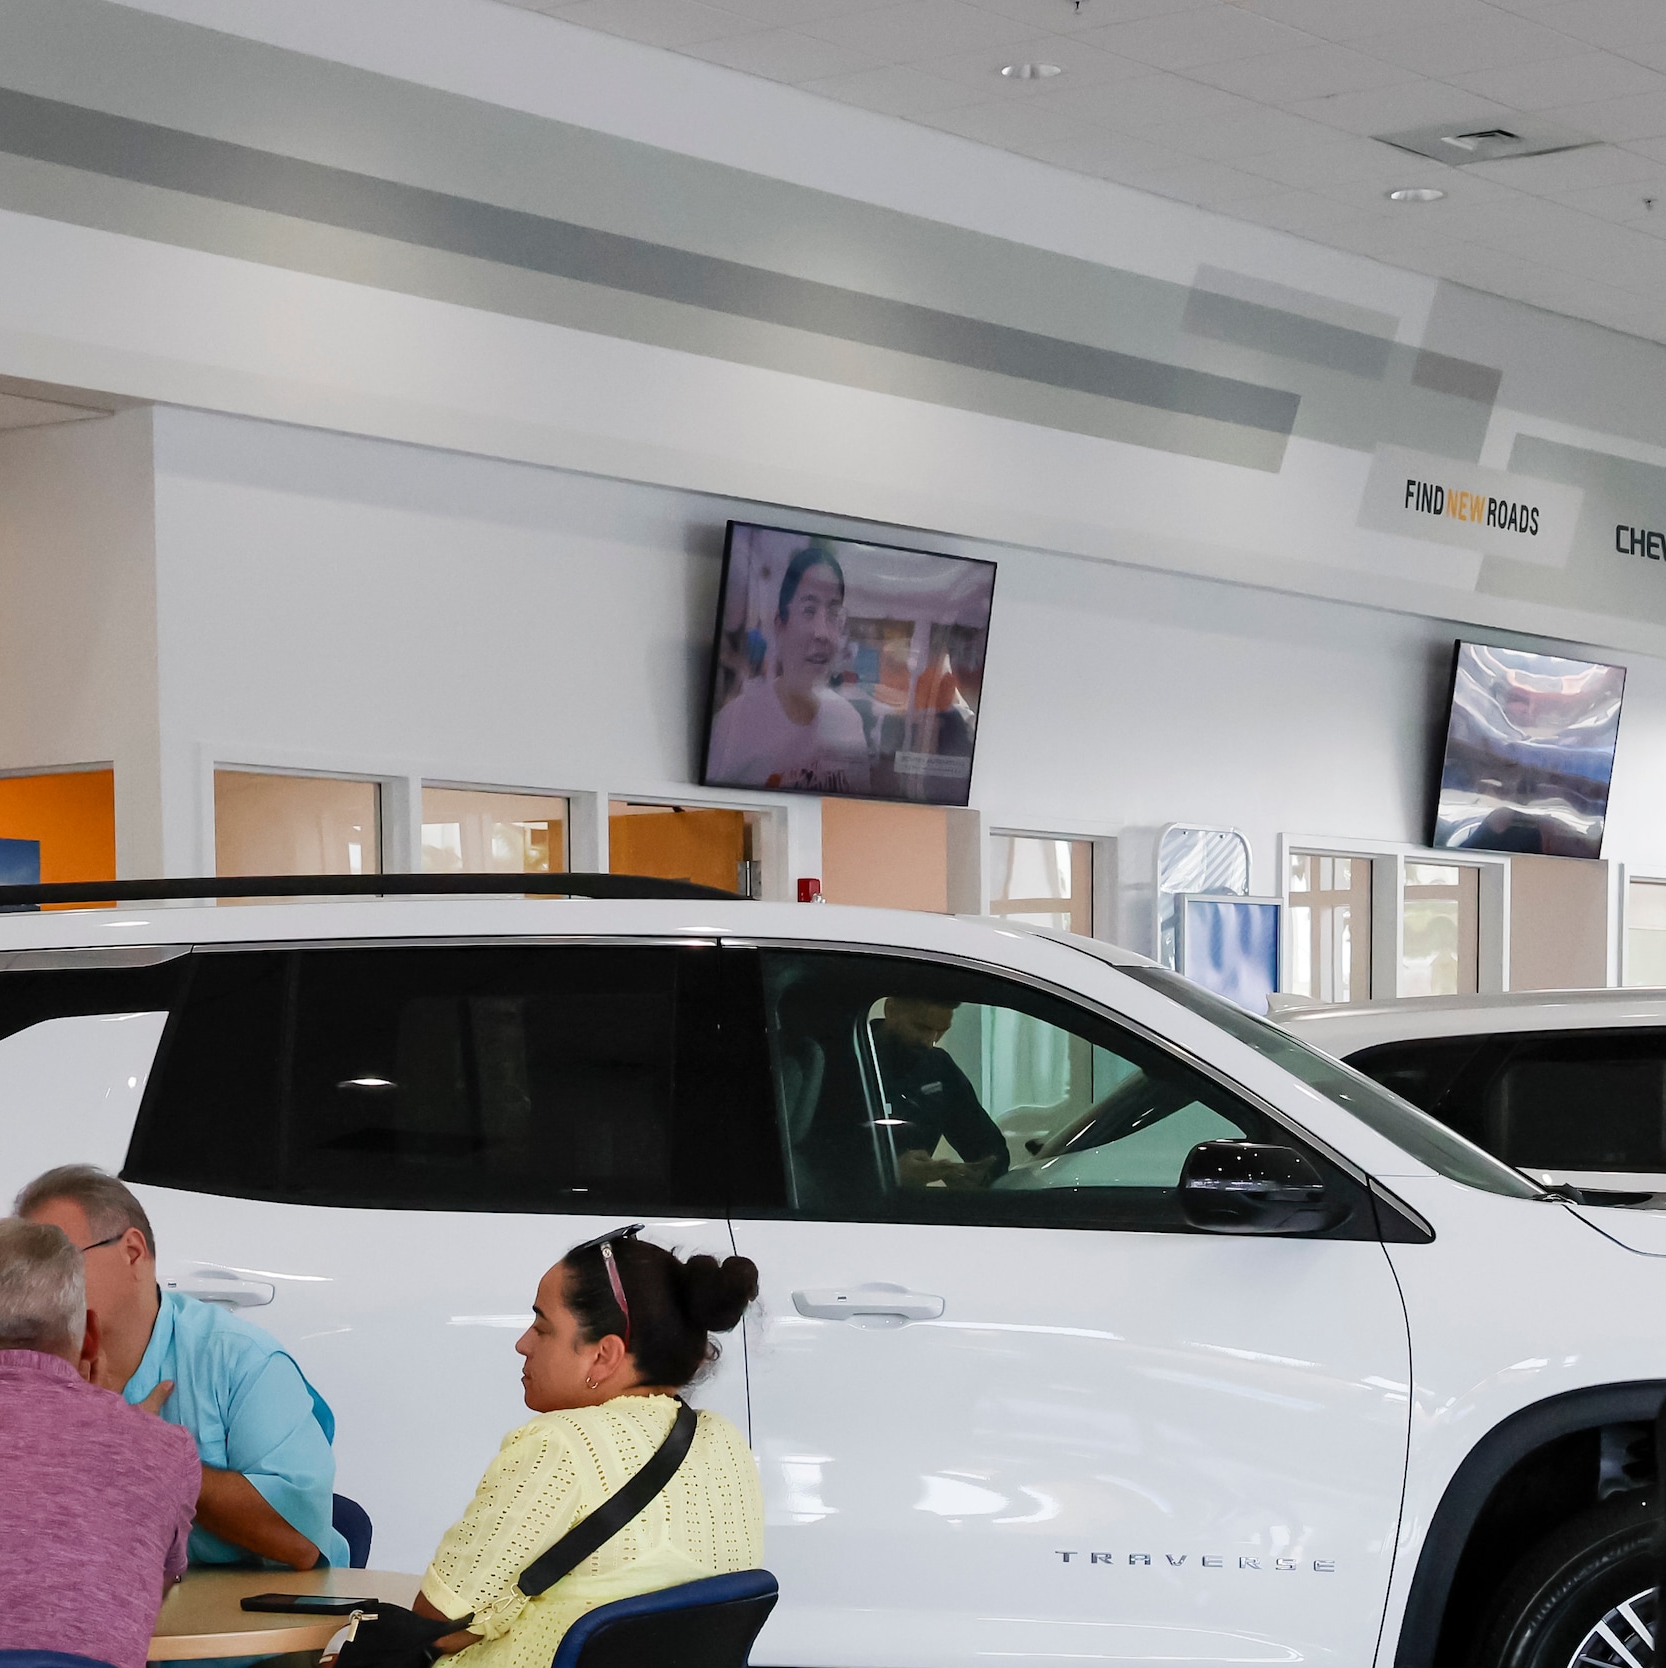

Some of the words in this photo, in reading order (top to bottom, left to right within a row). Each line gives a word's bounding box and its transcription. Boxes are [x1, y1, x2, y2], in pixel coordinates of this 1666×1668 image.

[1404, 479, 1445, 515] FIND
[1445, 488, 1486, 524] NEW
[1486, 497, 1540, 536] ROADS
[1054, 1550, 1336, 1573] TRAVERSE
